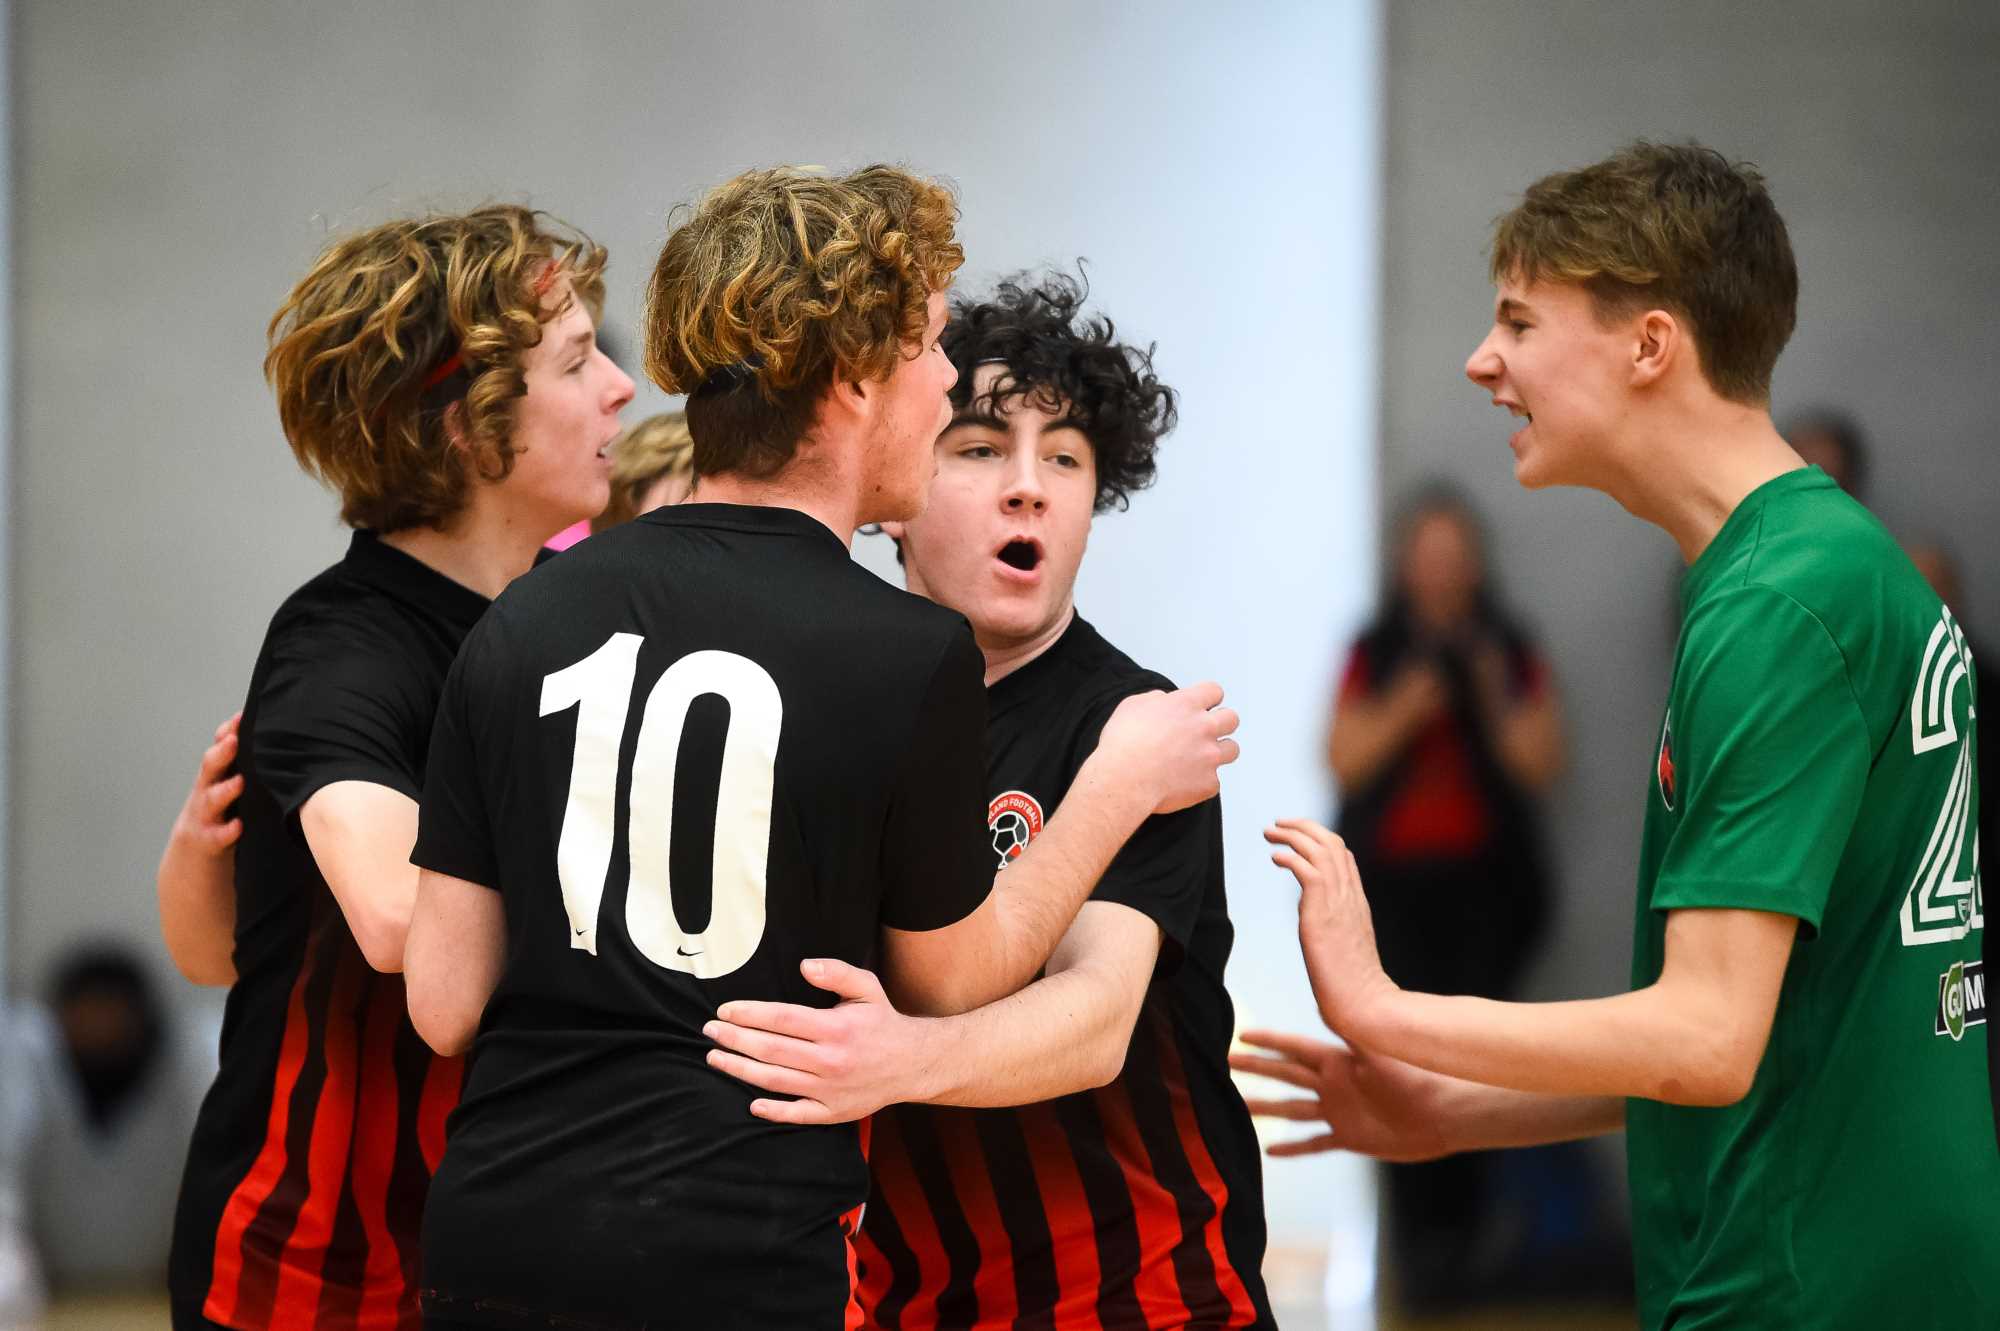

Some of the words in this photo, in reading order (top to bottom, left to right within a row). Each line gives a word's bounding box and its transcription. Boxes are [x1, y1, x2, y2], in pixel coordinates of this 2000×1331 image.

[539, 632, 783, 979] 10
[1009, 798, 1039, 829] FOOTBALL
[1900, 603, 1985, 947] 2
[1964, 973, 1986, 1012] M
